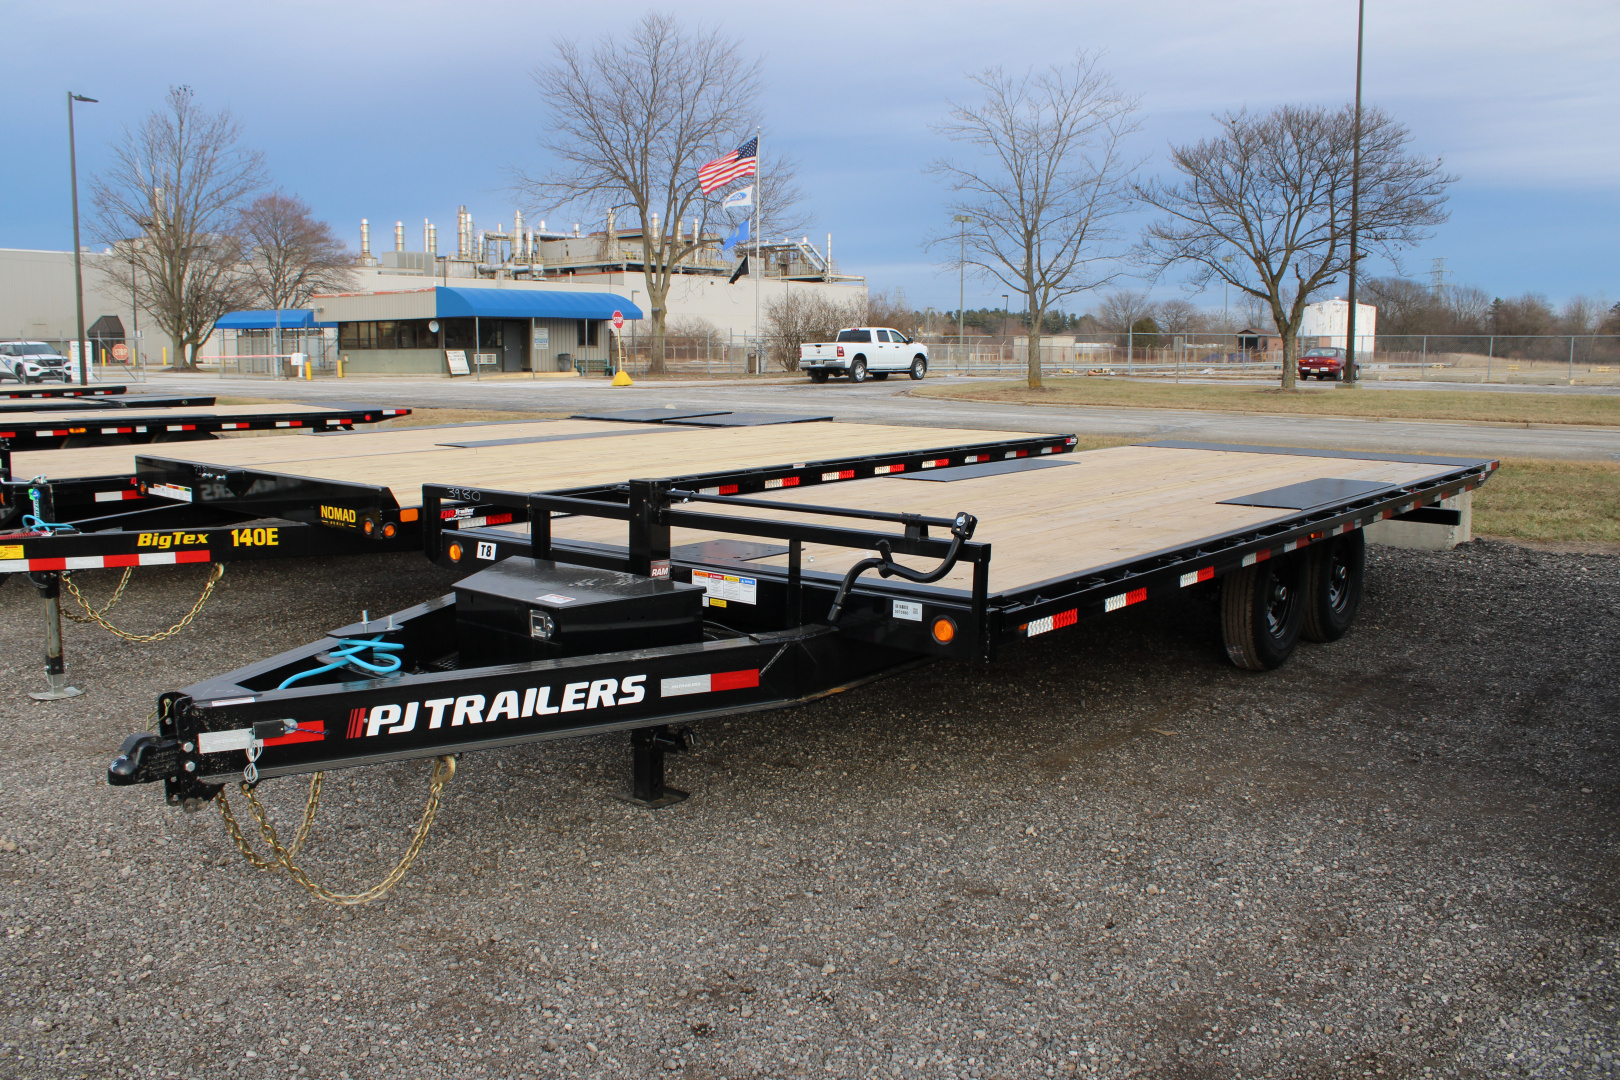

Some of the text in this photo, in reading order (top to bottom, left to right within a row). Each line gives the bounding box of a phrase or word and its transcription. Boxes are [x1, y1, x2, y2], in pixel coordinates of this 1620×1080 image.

[447, 487, 481, 501] 3980
[320, 505, 356, 523] NOMAD
[441, 510, 455, 518] DR
[137, 528, 279, 549] BigTex 140E
[481, 544, 492, 557] T8
[652, 567, 669, 577] RAM
[424, 675, 647, 730] TRAILERS
